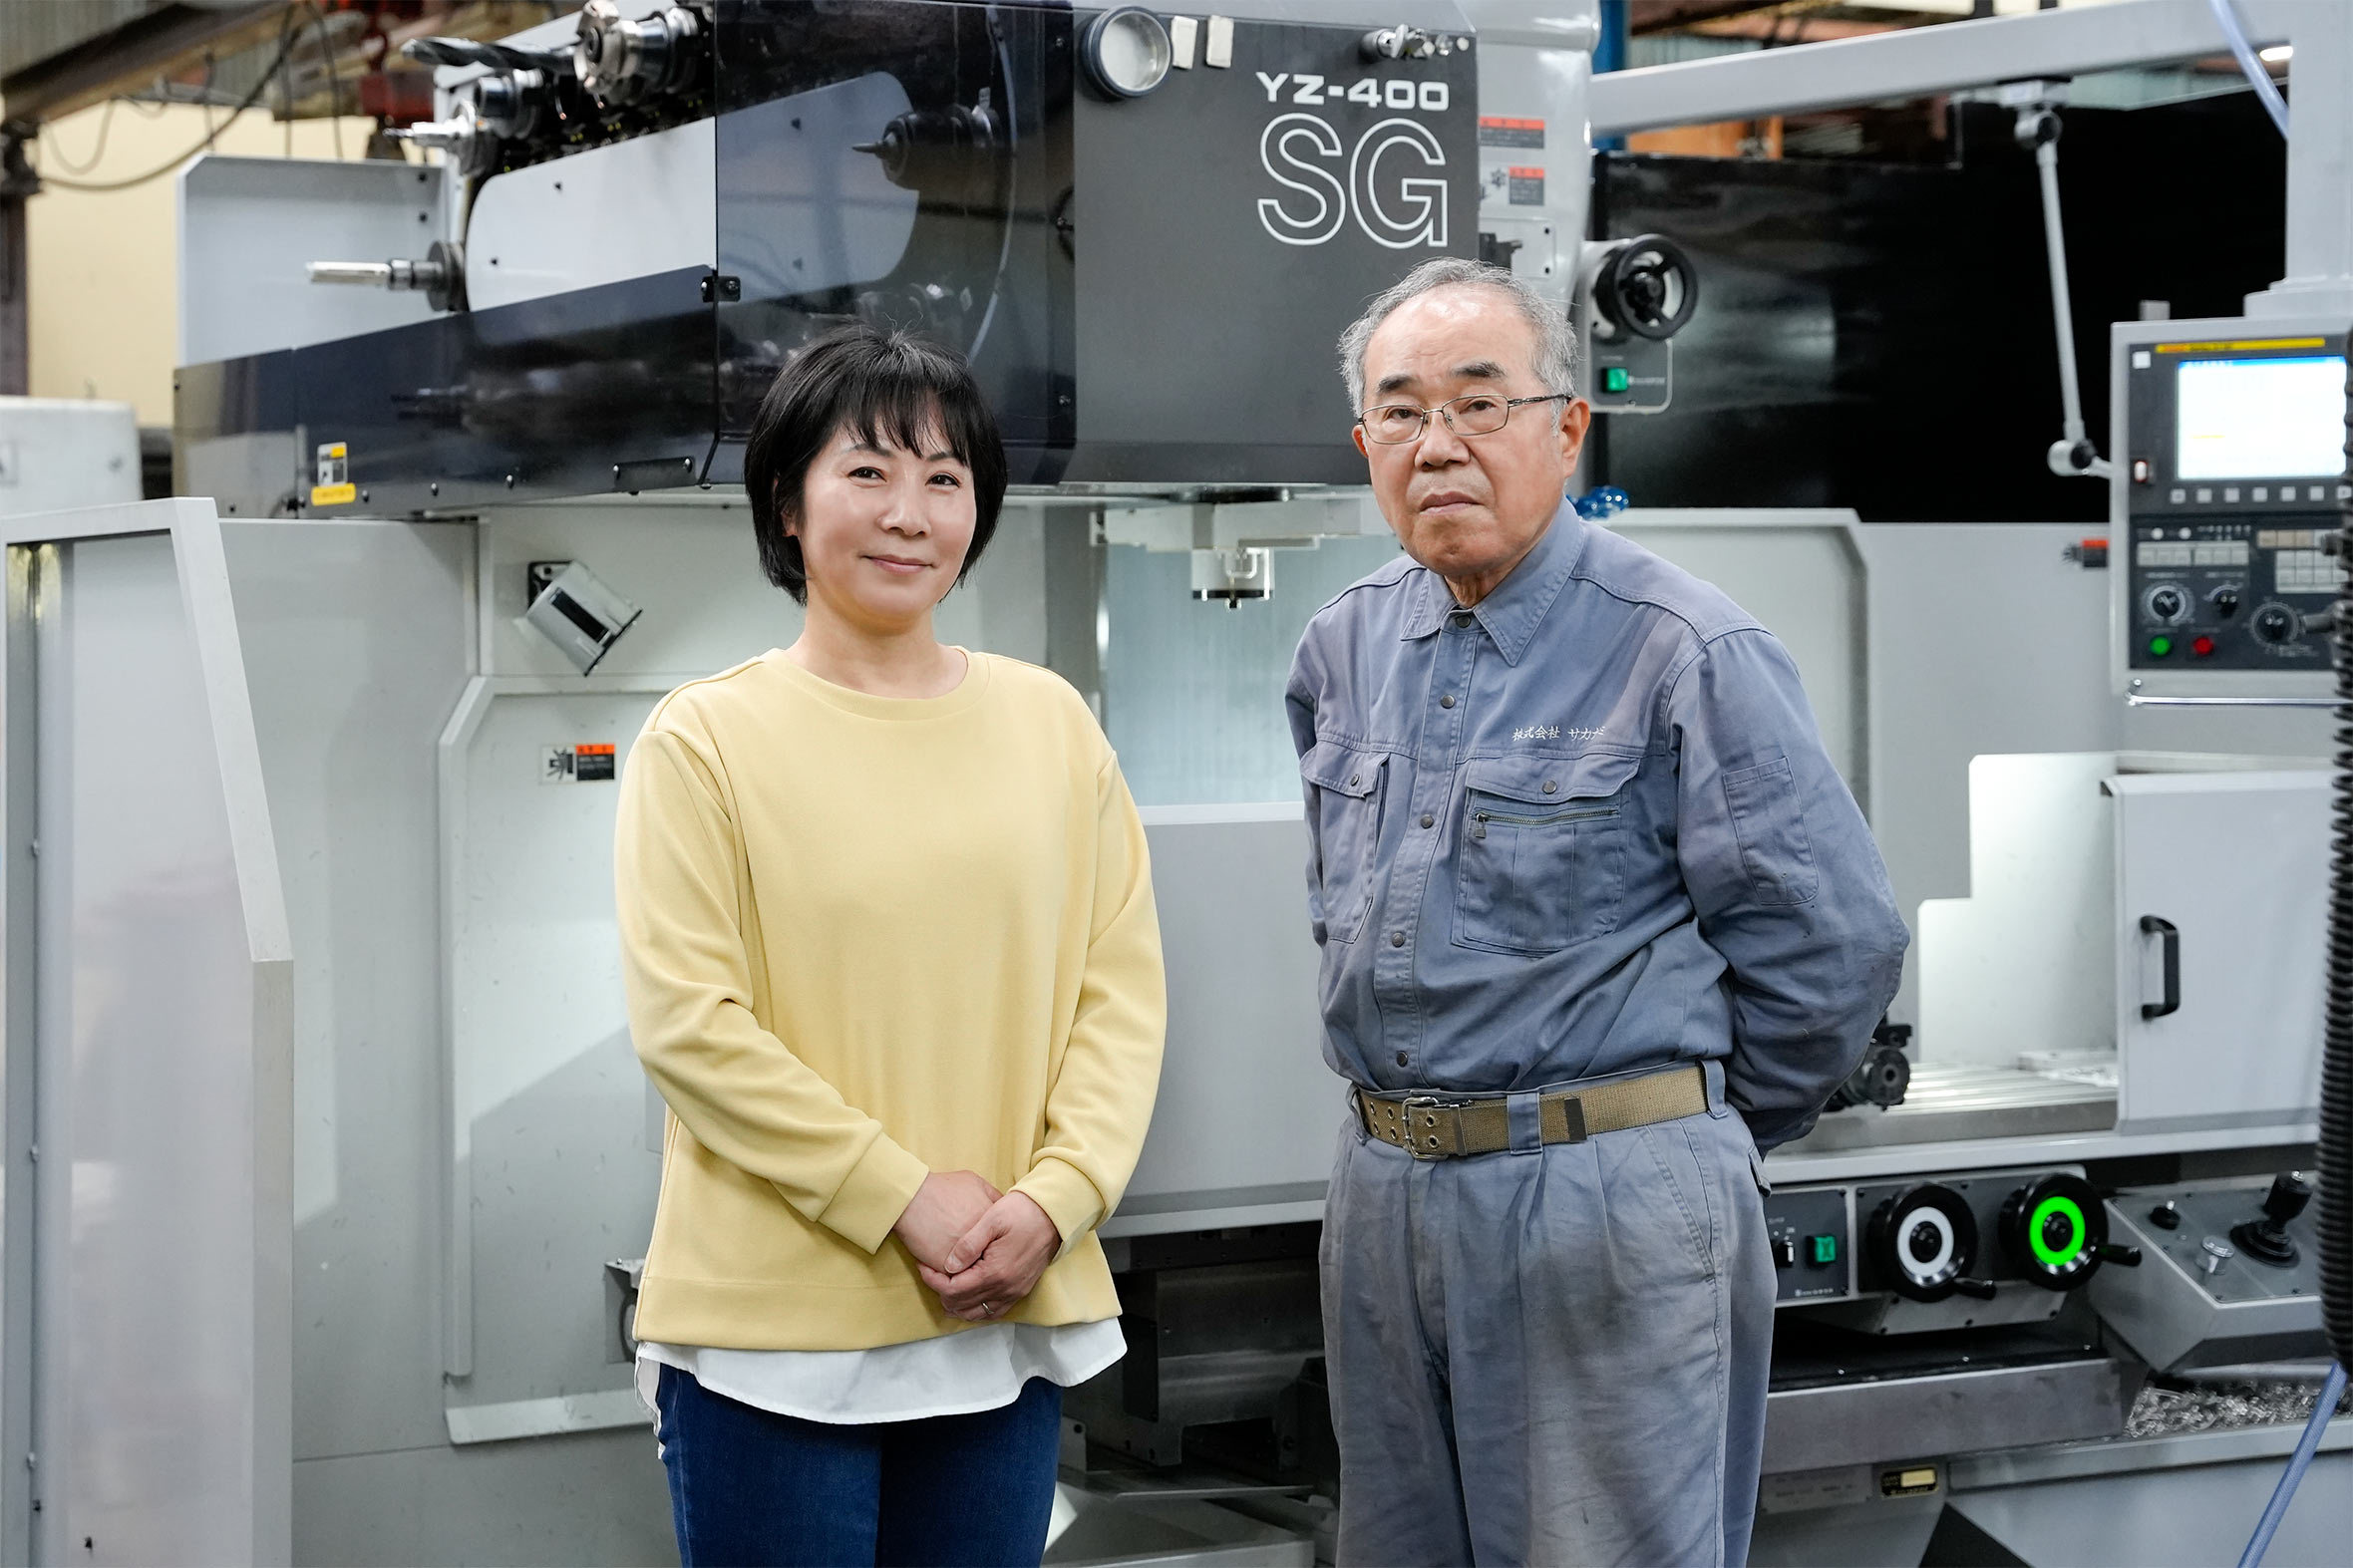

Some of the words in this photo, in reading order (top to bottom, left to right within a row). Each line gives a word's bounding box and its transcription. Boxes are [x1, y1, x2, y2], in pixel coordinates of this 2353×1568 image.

[1255, 71, 1450, 111] YZ-400
[1257, 113, 1448, 248] SG
[1513, 725, 1560, 742] 株式会社
